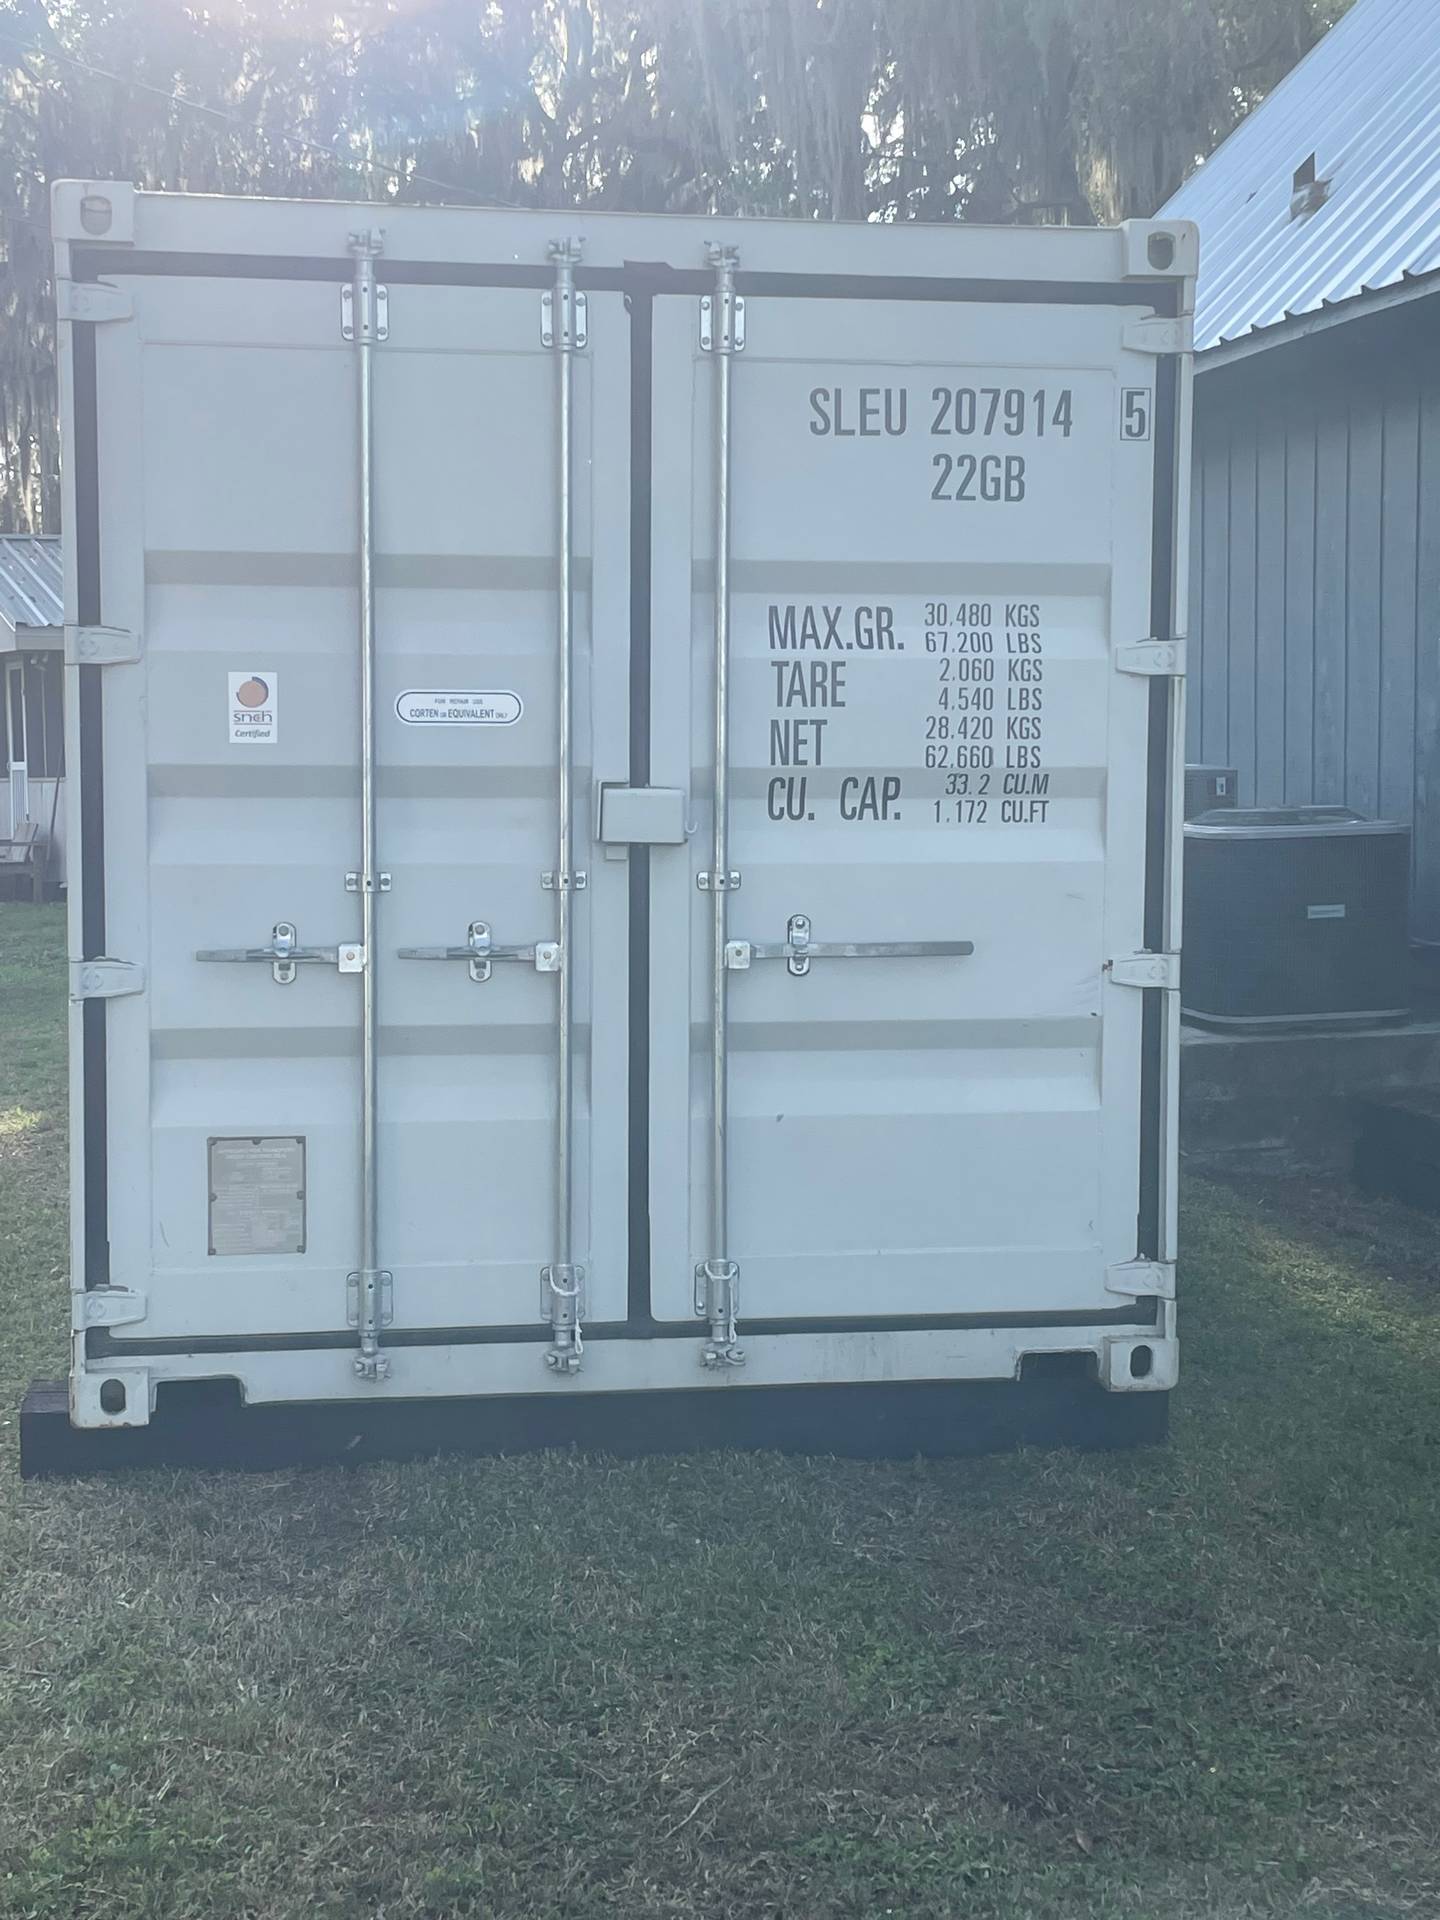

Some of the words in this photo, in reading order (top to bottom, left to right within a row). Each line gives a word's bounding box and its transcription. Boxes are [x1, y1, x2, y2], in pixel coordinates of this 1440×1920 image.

[809, 387, 907, 436] SLEU
[931, 387, 1072, 437] 207914
[1125, 390, 1146, 438] 5
[931, 453, 1025, 502] 22GB
[768, 605, 904, 650] MAX.GR.
[1005, 604, 1040, 627] KGS
[1007, 633, 1042, 653] LBS
[771, 661, 846, 707] TARE
[1008, 658, 1042, 682] KGS
[1008, 687, 1042, 710] LBS
[410, 709, 439, 718] CORTEN
[448, 709, 494, 718] EQUIVALENT
[235, 730, 271, 738] Certified
[770, 719, 828, 766] NET
[1007, 717, 1041, 739] KGS
[1006, 746, 1041, 768] LBS
[768, 777, 815, 820] CU.
[840, 777, 901, 820] CAP.
[1003, 773, 1049, 794] CU.M
[1001, 800, 1049, 823] CU.FT
